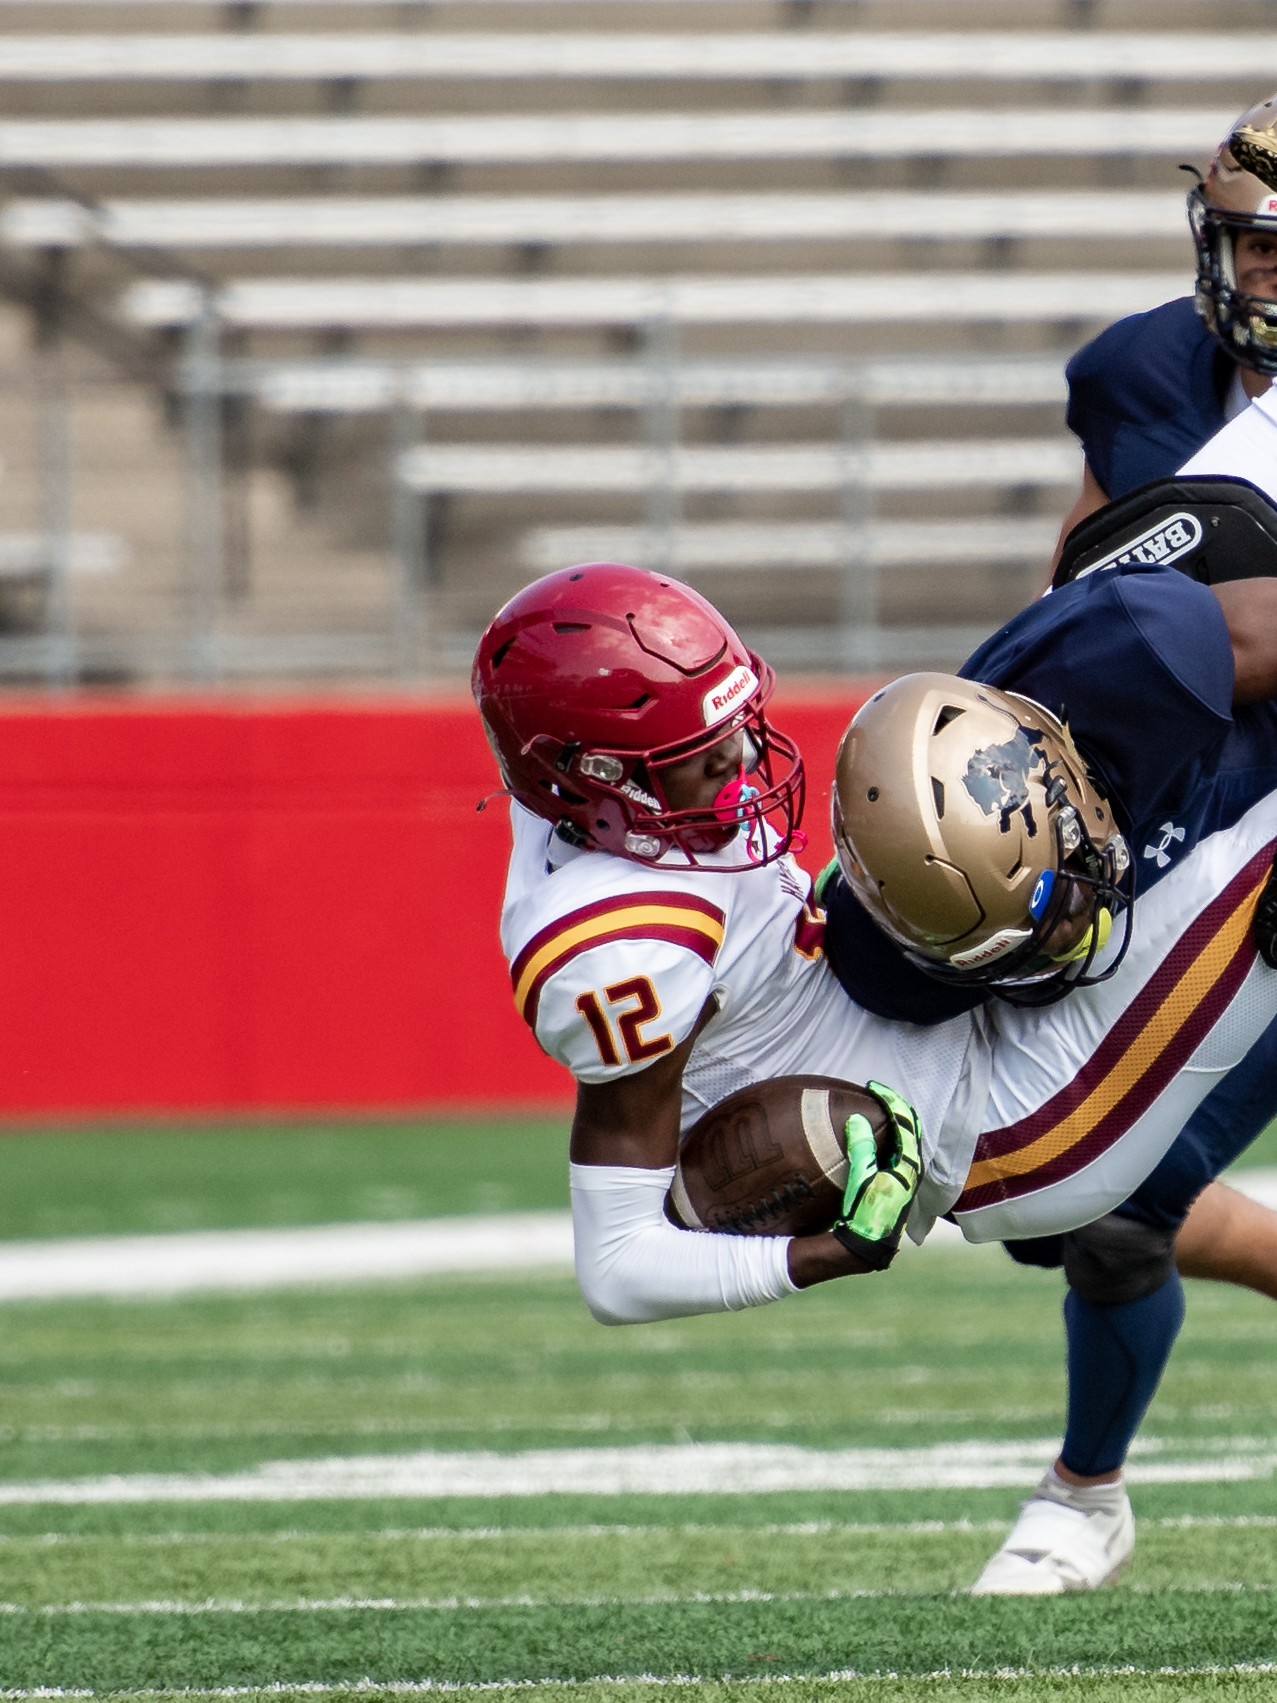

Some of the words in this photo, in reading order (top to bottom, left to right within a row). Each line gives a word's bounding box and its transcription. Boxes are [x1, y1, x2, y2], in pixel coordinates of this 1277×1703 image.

[711, 669, 751, 711] Riddell
[955, 938, 1012, 967] Riddell
[574, 974, 676, 1068] 12
